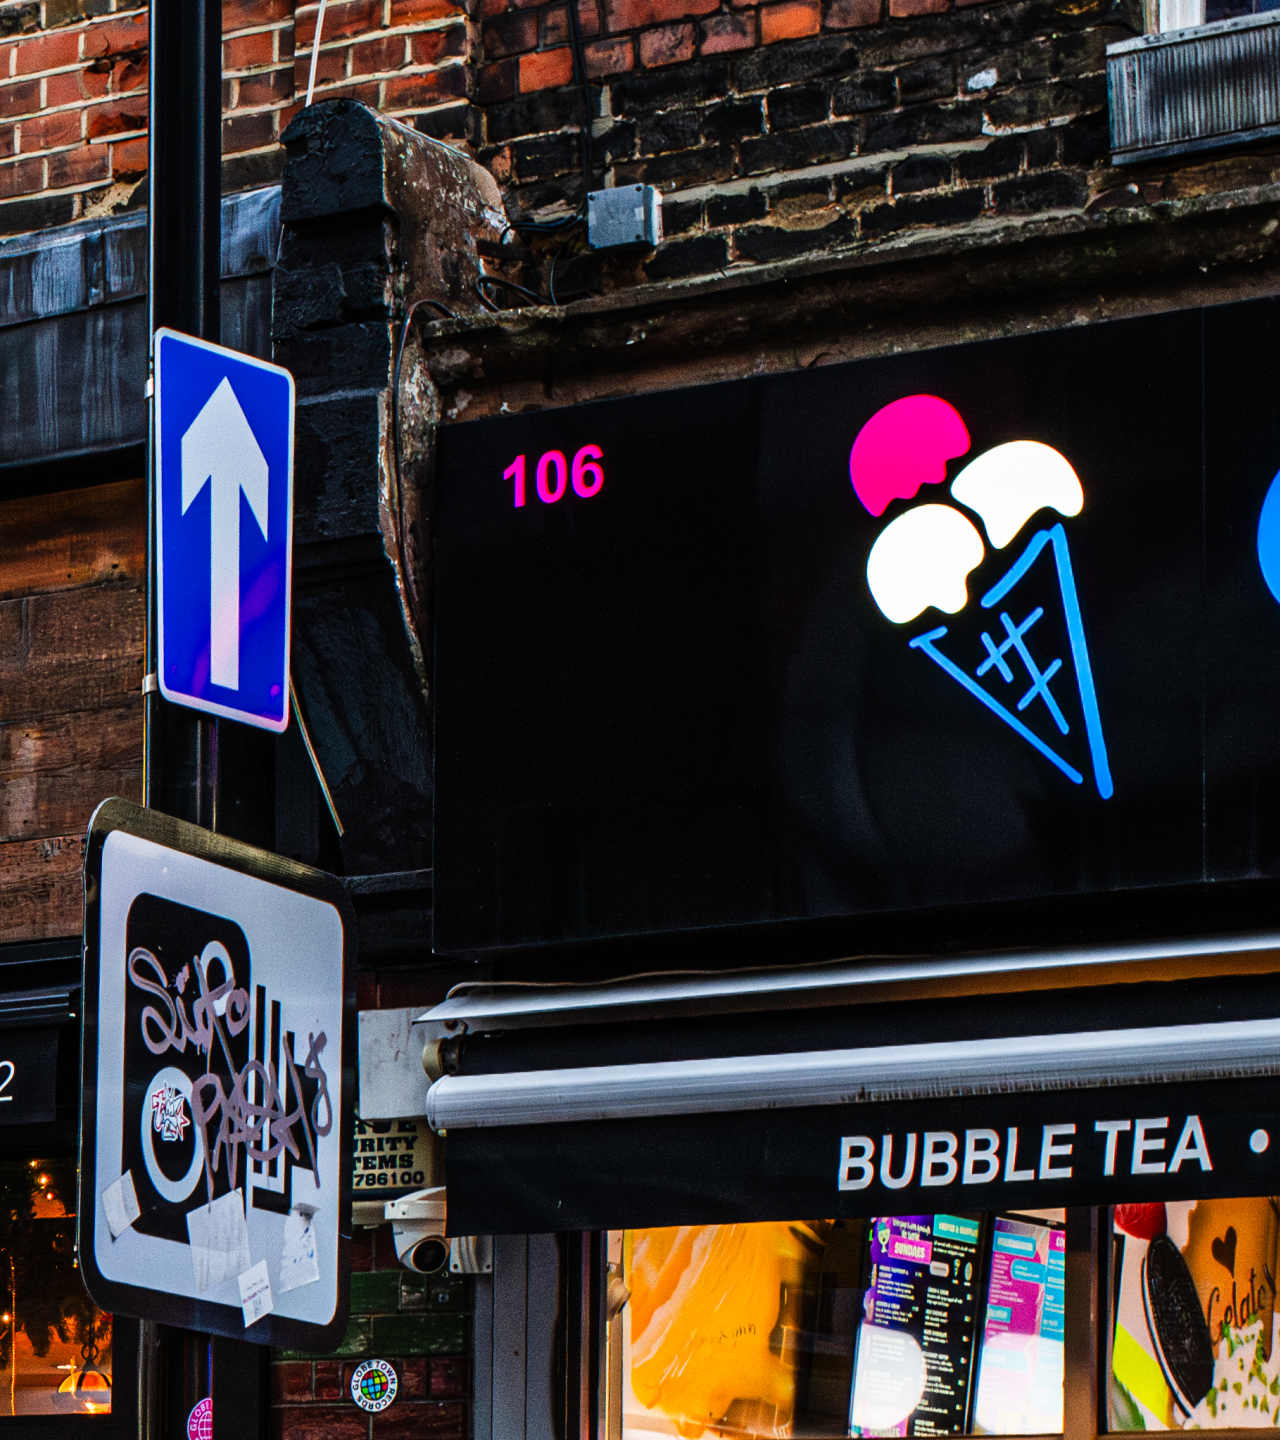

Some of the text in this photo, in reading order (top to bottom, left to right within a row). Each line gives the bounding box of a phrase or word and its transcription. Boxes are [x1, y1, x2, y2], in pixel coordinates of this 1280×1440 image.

[502, 444, 604, 507] 106
[838, 1114, 1214, 1192] BUBBLE TEA
